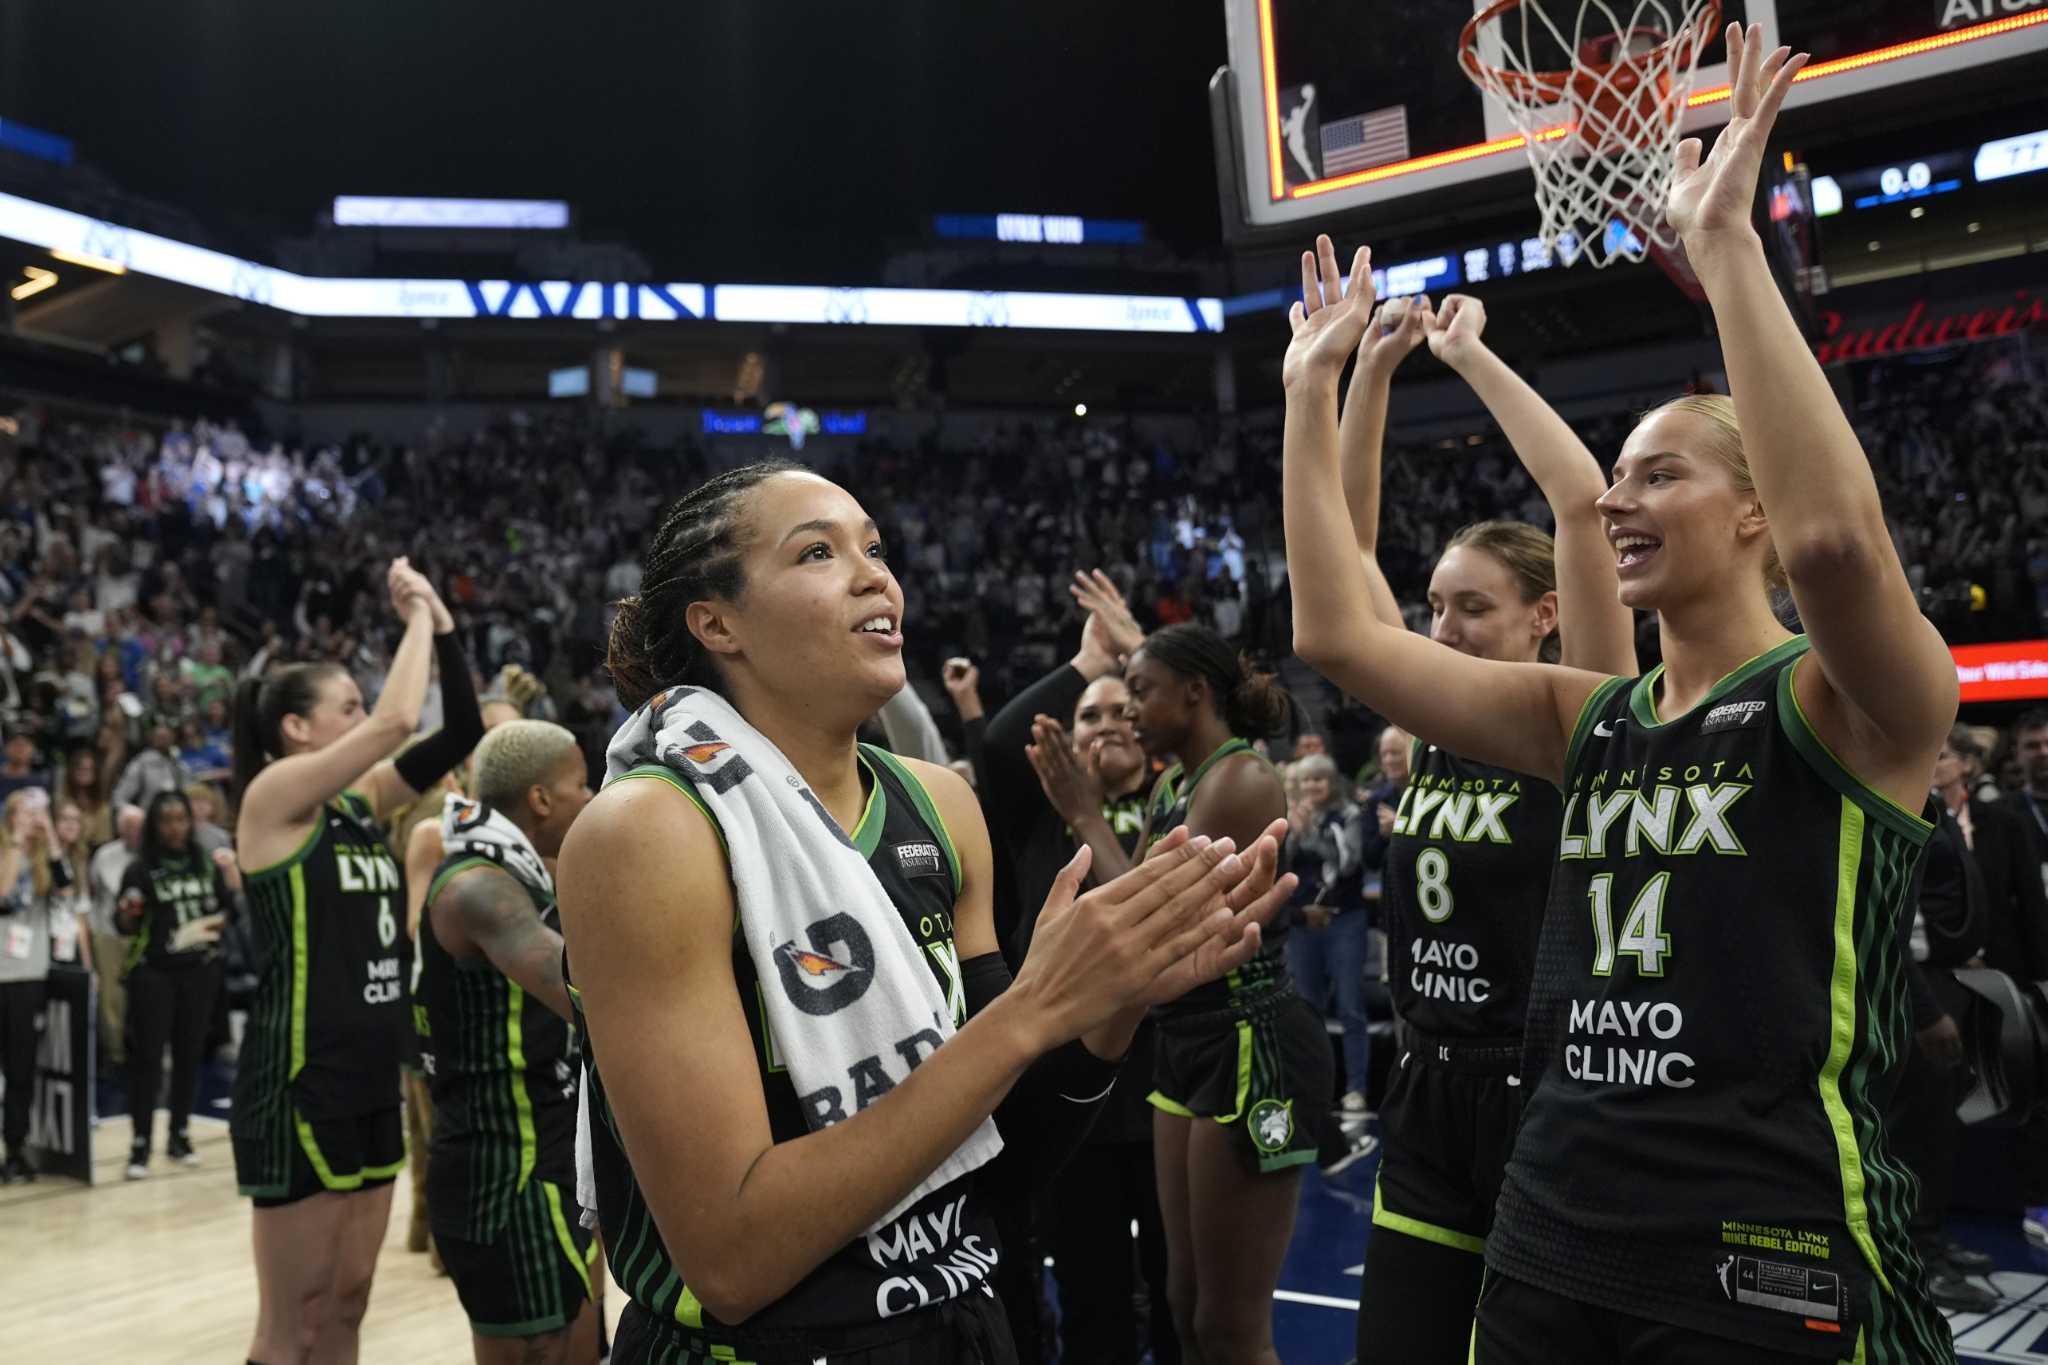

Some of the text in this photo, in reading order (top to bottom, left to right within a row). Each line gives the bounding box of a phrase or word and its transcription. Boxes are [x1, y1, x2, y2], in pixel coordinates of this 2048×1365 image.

[1880, 162, 1931, 196] 0.0
[463, 279, 716, 320] WIN
[1392, 786, 1520, 844] LYNX
[1560, 782, 1753, 861] LYNX
[336, 852, 400, 892] LYN
[897, 844, 940, 860] FEDERATED
[1416, 848, 1454, 923] 8
[378, 896, 397, 948] 6
[1587, 870, 1673, 978] 14
[1569, 999, 1683, 1040] MAYO
[1565, 1043, 1696, 1089] CLINIC
[1722, 1221, 1830, 1246] MINNESOTA LYNX
[1722, 1231, 1830, 1259] NIKE REBEL EDITION
[876, 1234, 999, 1319] CLINIC
